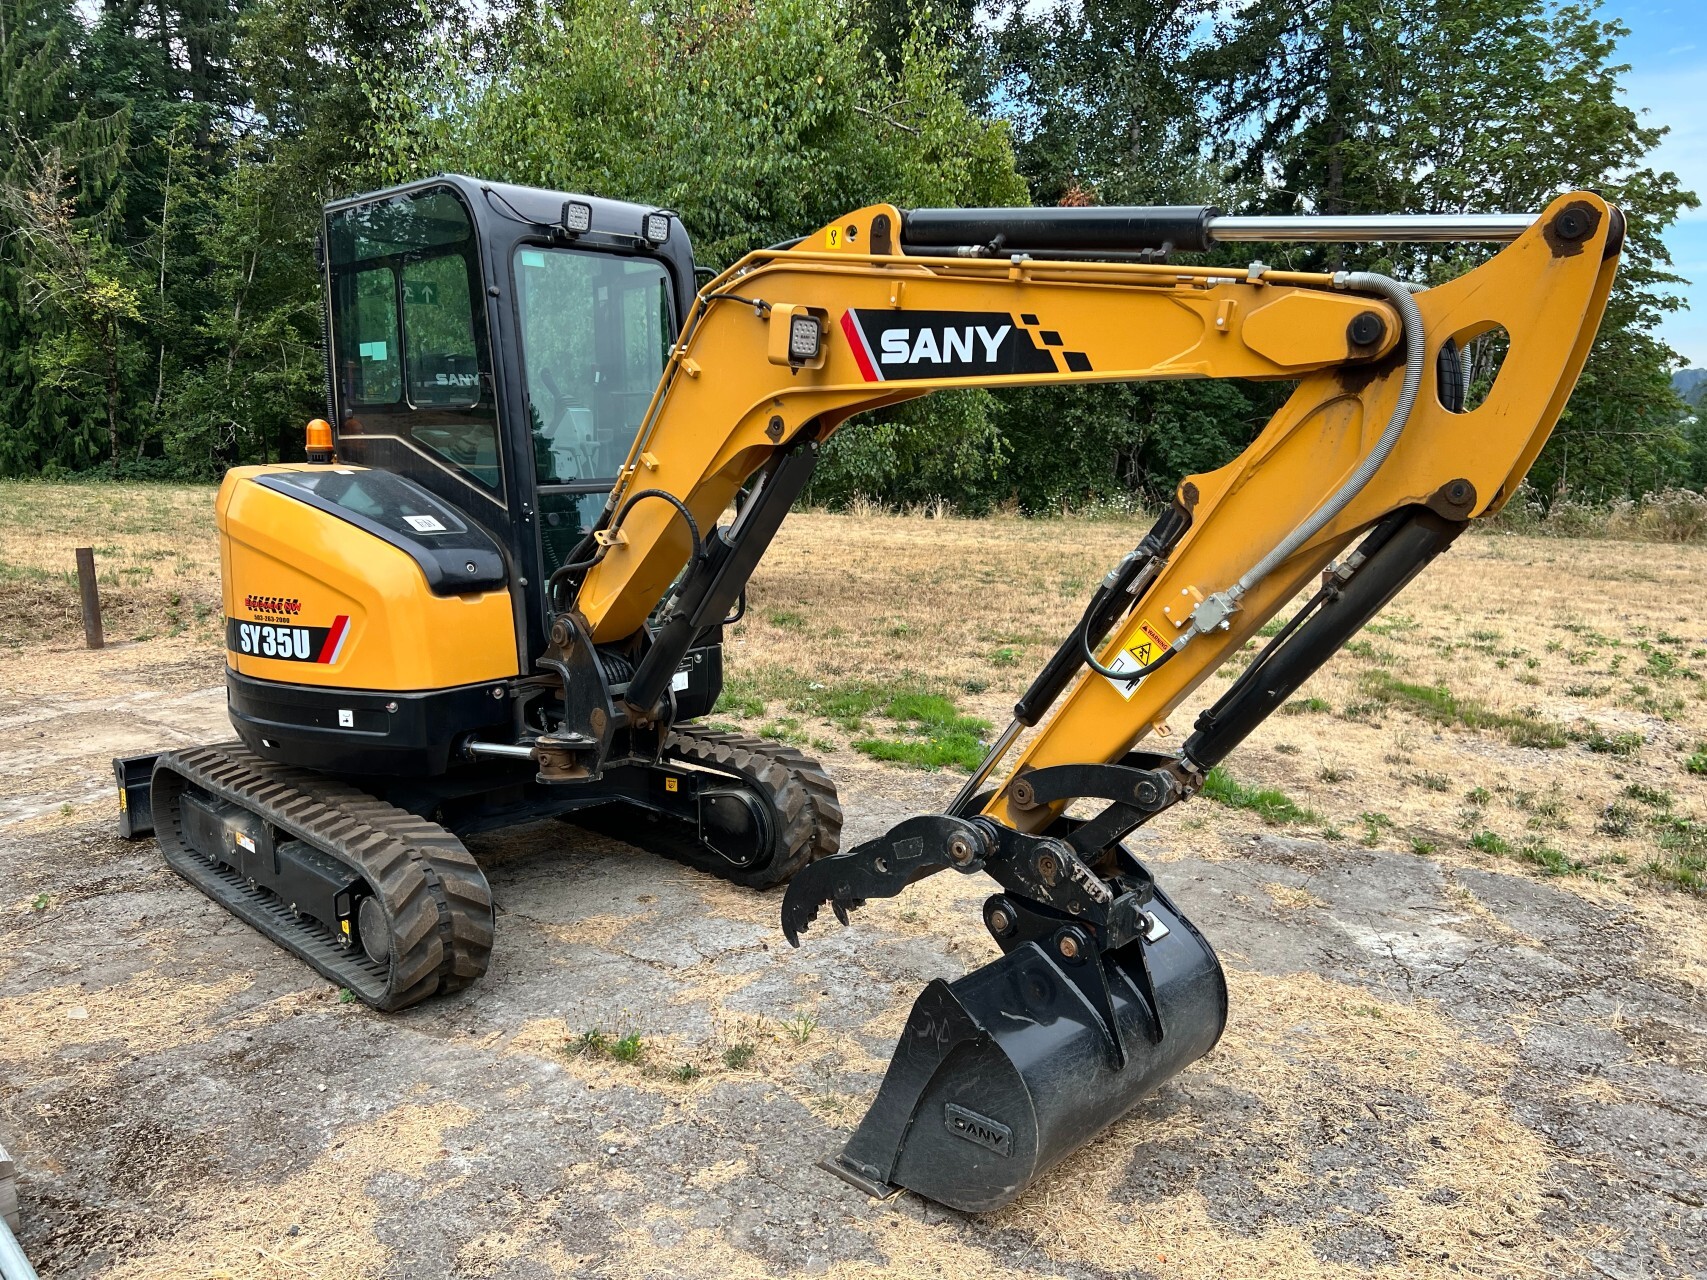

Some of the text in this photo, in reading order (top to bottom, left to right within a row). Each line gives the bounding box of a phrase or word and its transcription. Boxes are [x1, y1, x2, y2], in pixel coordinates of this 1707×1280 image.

[881, 325, 1012, 364] SANY
[240, 623, 311, 660] SY35U
[1147, 629, 1169, 651] WARNING
[954, 1117, 1003, 1145] SANY
